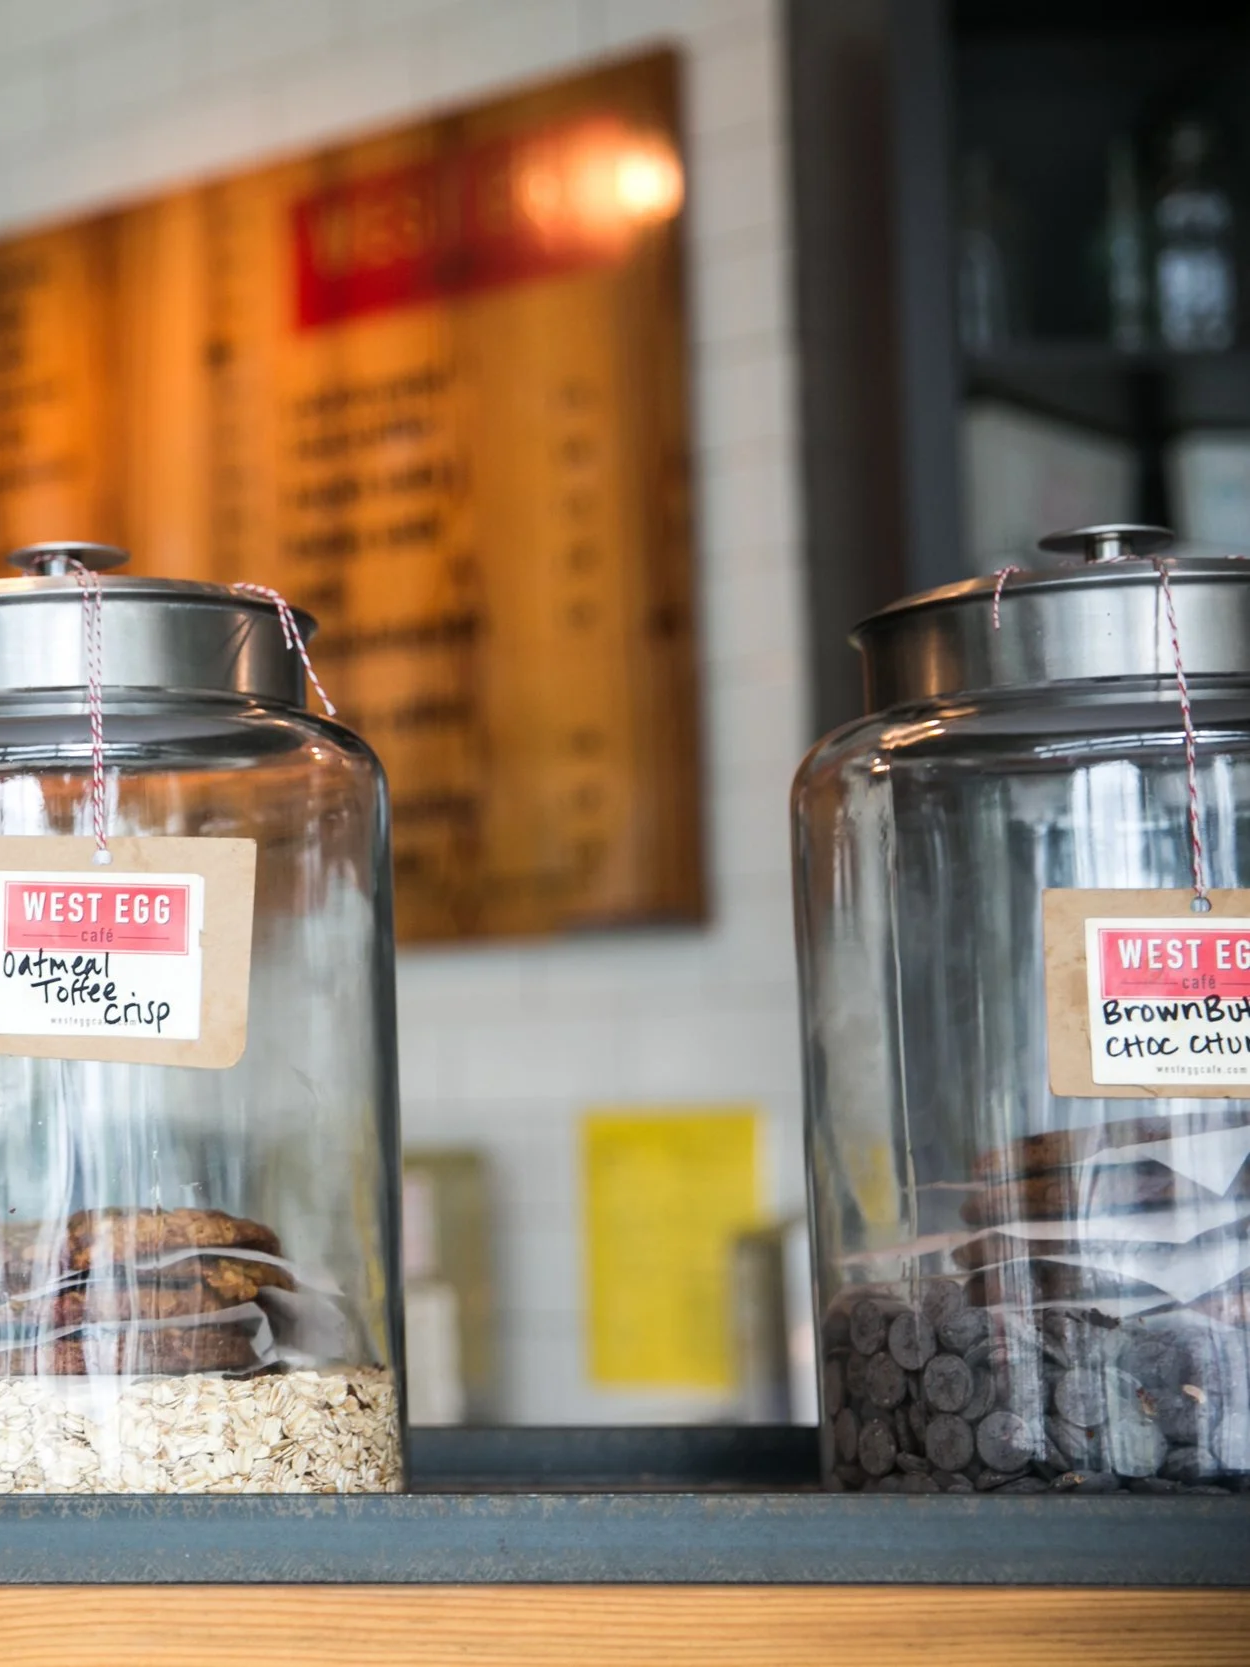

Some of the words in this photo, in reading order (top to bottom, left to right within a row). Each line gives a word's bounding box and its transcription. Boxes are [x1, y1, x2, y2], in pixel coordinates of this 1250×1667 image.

[23, 891, 103, 923] WEST
[114, 893, 171, 925] EGG
[81, 927, 113, 943] café
[3, 947, 110, 979] Oatmeal
[1117, 938, 1202, 970] WEST
[30, 976, 118, 1006] Toffee
[1182, 973, 1217, 990] café
[1105, 1034, 1180, 1058] CHOC
